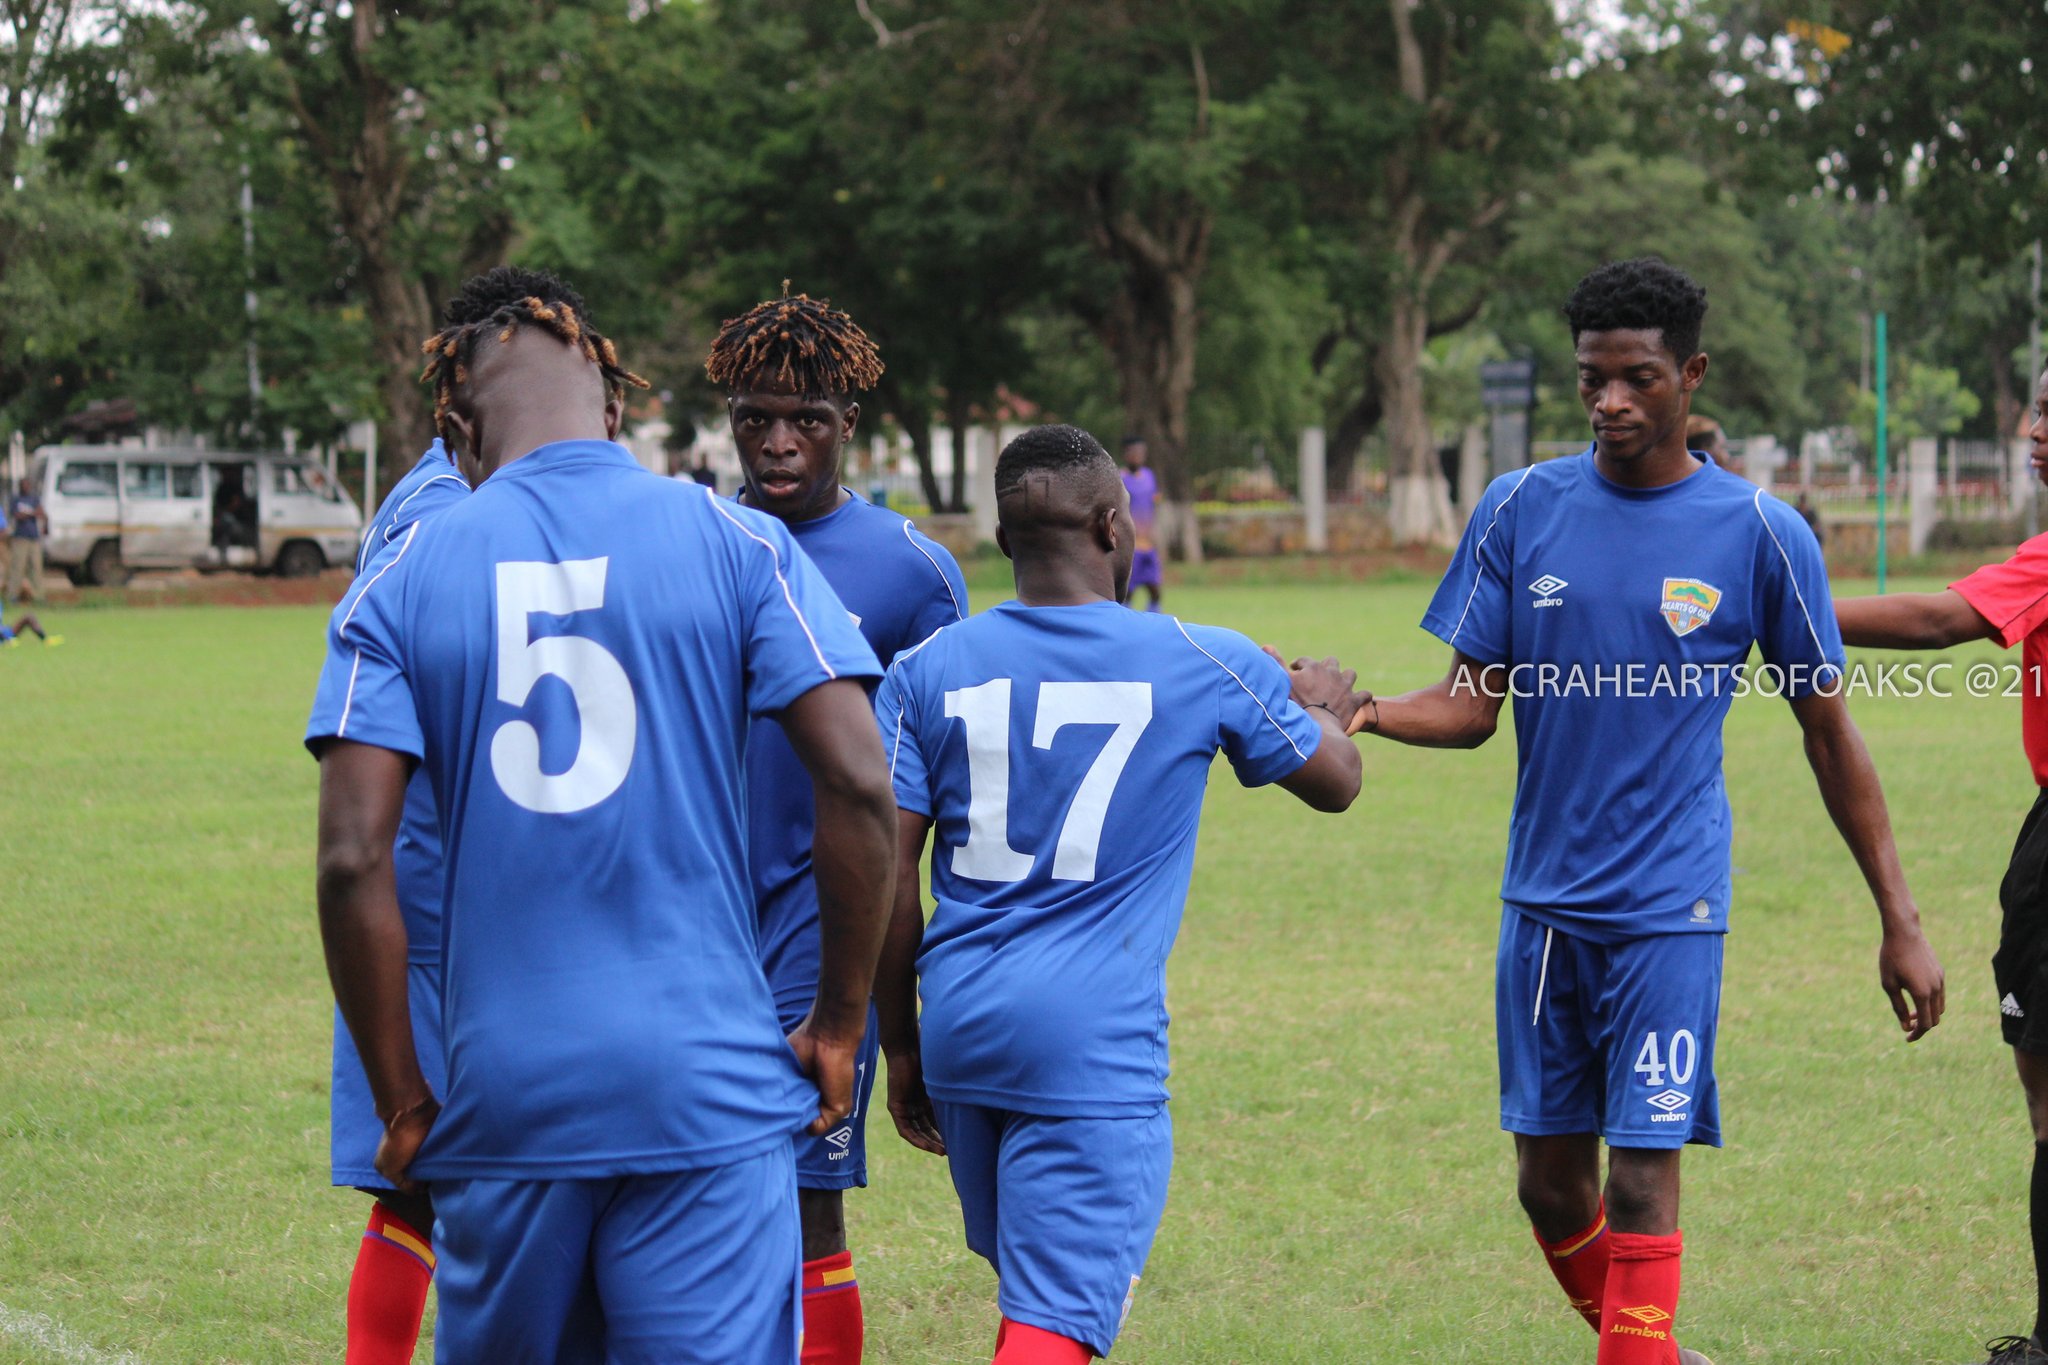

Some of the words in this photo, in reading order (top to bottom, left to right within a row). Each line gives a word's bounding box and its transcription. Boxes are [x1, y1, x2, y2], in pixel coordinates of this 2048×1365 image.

[1532, 596, 1564, 609] umbro
[1660, 600, 1688, 613] HEARTS
[1687, 604, 1699, 614] OF
[490, 556, 636, 813] 5
[944, 678, 1153, 883] 17
[1633, 1028, 1696, 1086] 40
[1650, 1111, 1687, 1123] umbro
[1610, 1323, 1668, 1341] umbro
